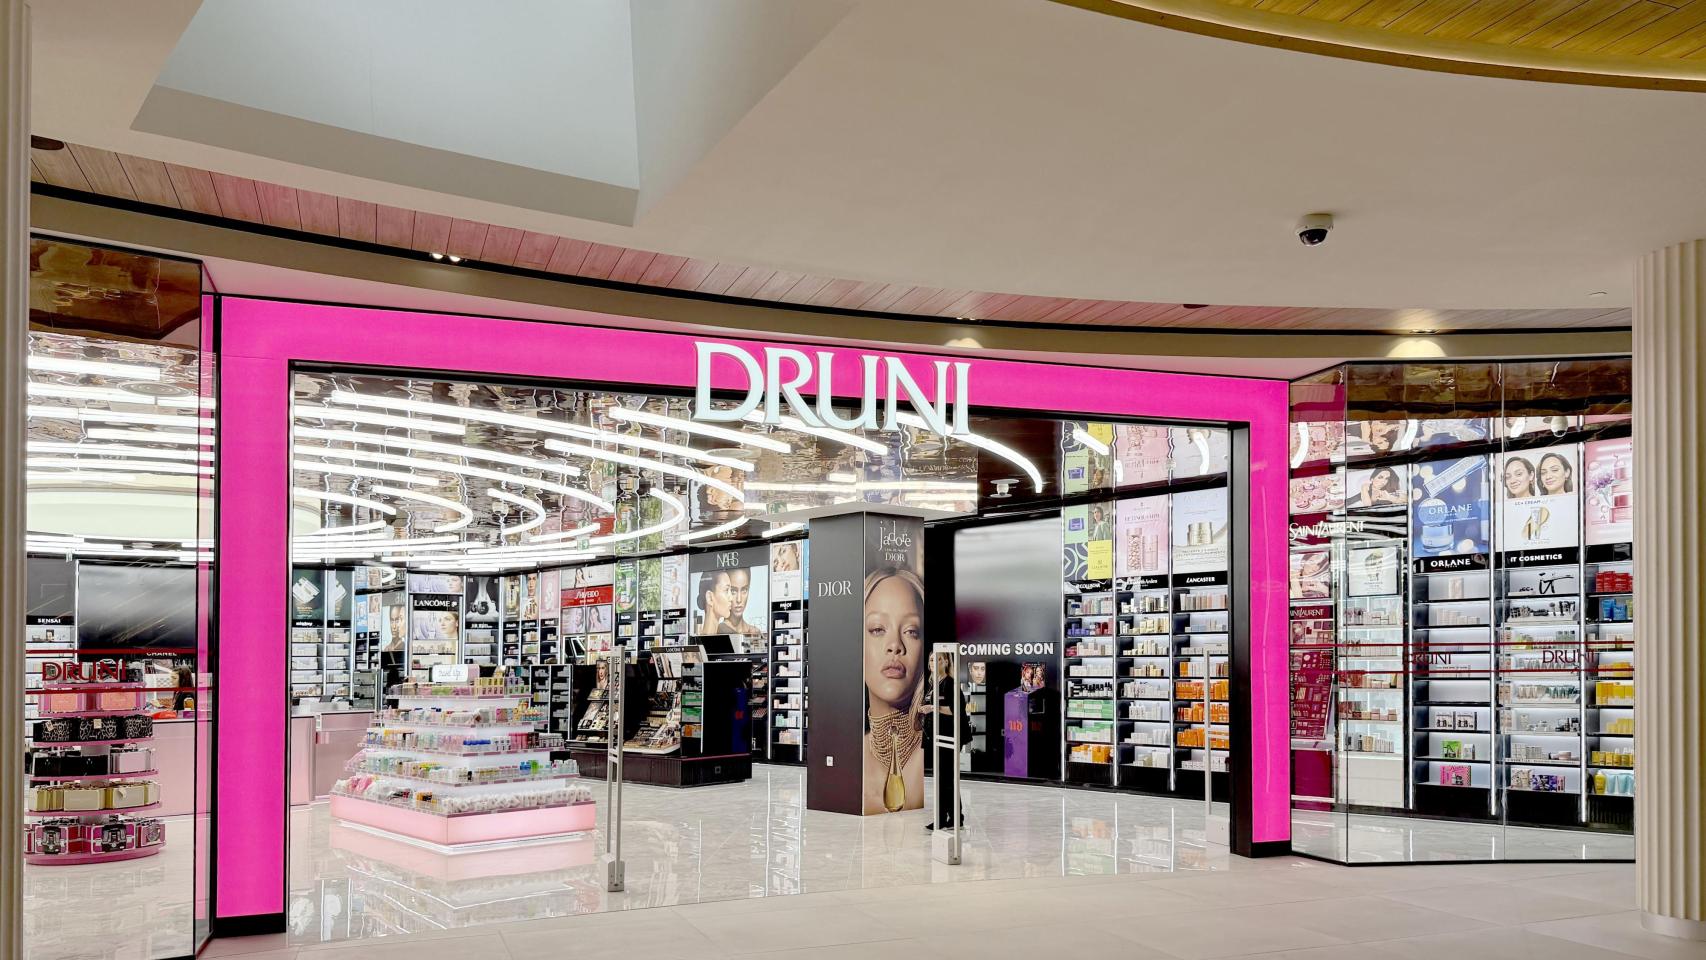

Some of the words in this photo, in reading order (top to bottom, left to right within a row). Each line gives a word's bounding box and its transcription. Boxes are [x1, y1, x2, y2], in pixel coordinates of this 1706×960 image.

[692, 341, 971, 437] DRUNI
[1428, 503, 1473, 515] ORLANE
[716, 551, 739, 569] NARS
[885, 552, 905, 562] DIOR
[1430, 558, 1471, 568] ORLANE
[1519, 553, 1563, 562] COSMETICS
[1186, 576, 1215, 584] LANCASTER
[817, 580, 852, 597] DIOR
[37, 617, 61, 625] SENSAI
[960, 643, 1011, 656] COMING
[1014, 642, 1054, 655] SOON
[1543, 649, 1595, 664] DRUNI
[42, 660, 126, 681] DRUNI
